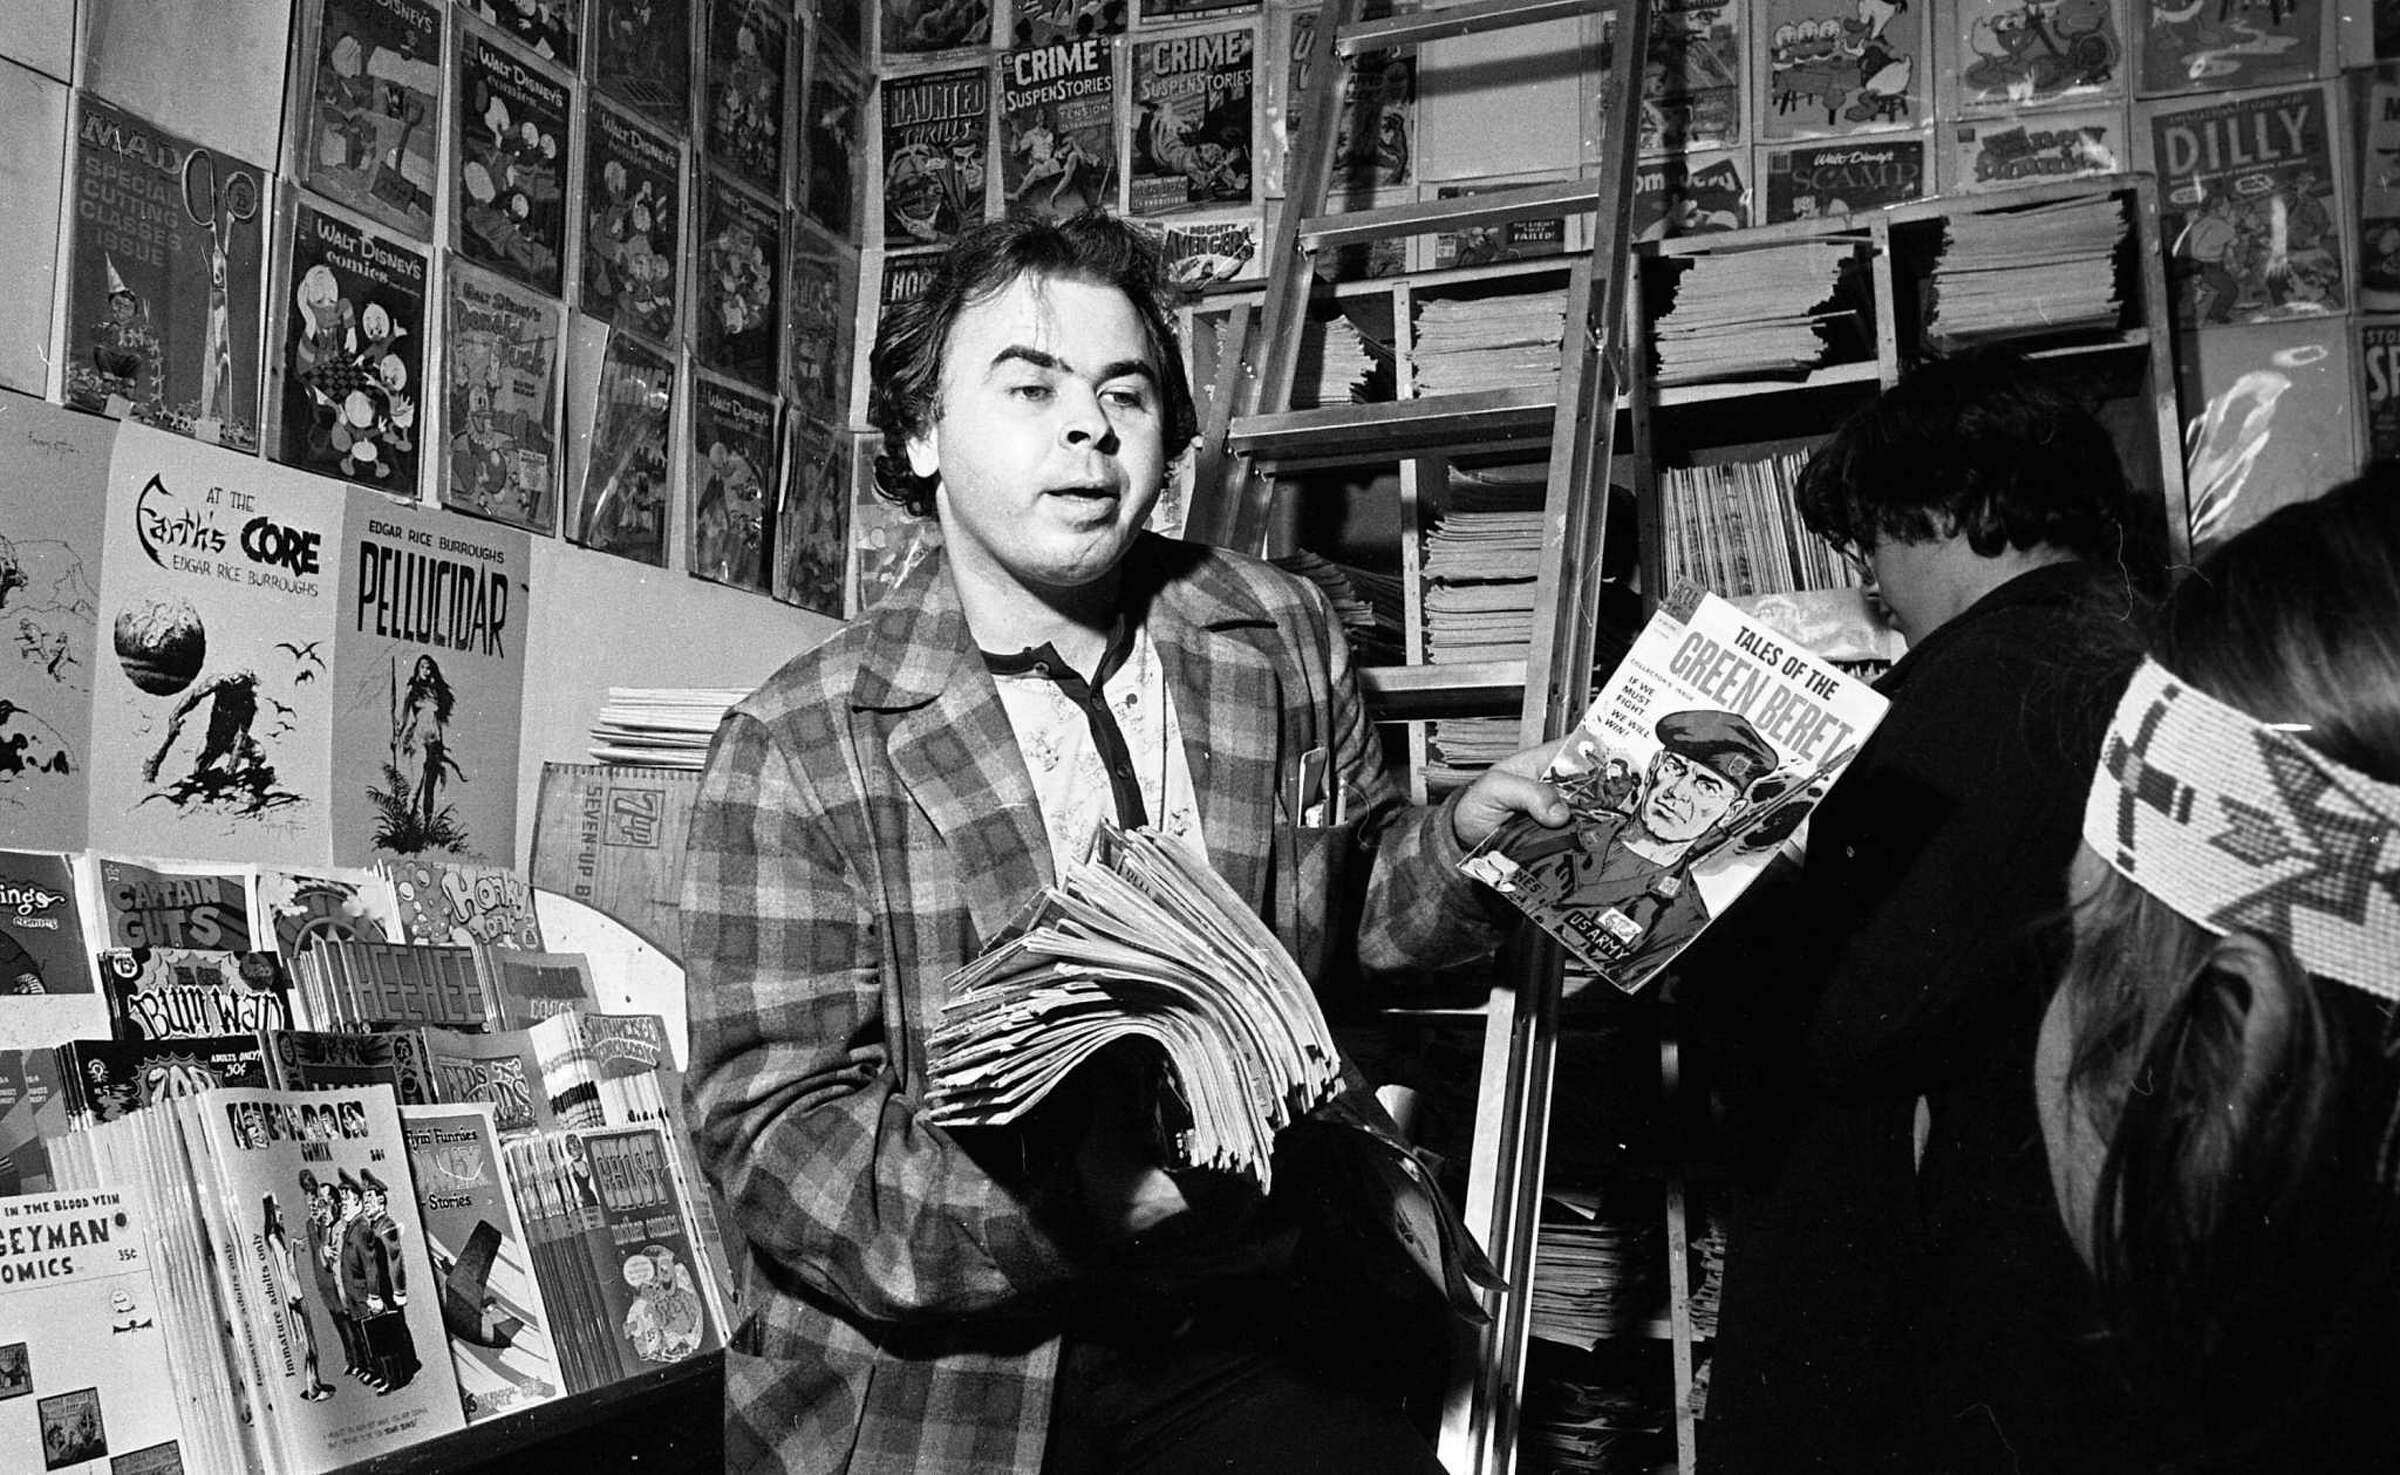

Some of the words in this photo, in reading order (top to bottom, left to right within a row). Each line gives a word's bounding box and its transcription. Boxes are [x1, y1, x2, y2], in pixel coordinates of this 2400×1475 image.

[1014, 40, 1099, 86] CRIME
[1153, 31, 1241, 75] CRIME
[80, 110, 184, 174] MAD
[2164, 105, 2310, 176] DILLY
[85, 157, 179, 209] SPECIAL
[1792, 162, 1919, 191] SCAMP
[83, 178, 178, 229] CUTTING
[317, 218, 357, 252] WALT
[359, 235, 422, 280] DISNEY'S
[206, 487, 222, 505] AT
[230, 491, 255, 513] THE
[136, 472, 229, 571] Earth's
[240, 516, 321, 578] CORE
[369, 520, 402, 539] EDGAR
[408, 530, 432, 547] RICE
[440, 537, 504, 564] BURROUGHS
[173, 554, 210, 576] EDGAR
[217, 562, 242, 583] RICE
[248, 571, 319, 598] BURROUGHS
[357, 540, 509, 660] PELLUCIDAR
[1629, 676, 1639, 684] IF
[1640, 682, 1655, 696] WE
[1734, 626, 1783, 667] TALES
[1781, 656, 1808, 681] OF
[1805, 669, 1840, 702] THE
[1622, 685, 1651, 706] MUST
[1669, 631, 1772, 715] GREEN
[1753, 684, 1855, 768] BERET
[1604, 719, 1630, 736] WIN!
[1611, 709, 1628, 722] WE
[1628, 719, 1650, 738] WILL
[577, 786, 602, 878] SEVEN-UP
[111, 877, 221, 912] CAPTAIN
[118, 905, 221, 949] GUTS
[1570, 913, 1592, 931] US
[1587, 928, 1630, 961] ARMY
[211, 1052, 237, 1063] ADULTS
[225, 1062, 247, 1078] 50¢
[149, 1064, 216, 1102] ZAP
[433, 1126, 477, 1143] Funnies
[4, 1207, 19, 1217] IN
[24, 1202, 50, 1215] THE
[54, 1198, 89, 1211] BLOOD
[92, 1194, 120, 1205] VEIN
[429, 1192, 472, 1210] Stories
[252, 1233, 267, 1262] only
[1, 1256, 74, 1284] OMICS
[262, 1265, 278, 1306] adults
[273, 1311, 296, 1378] Immature
